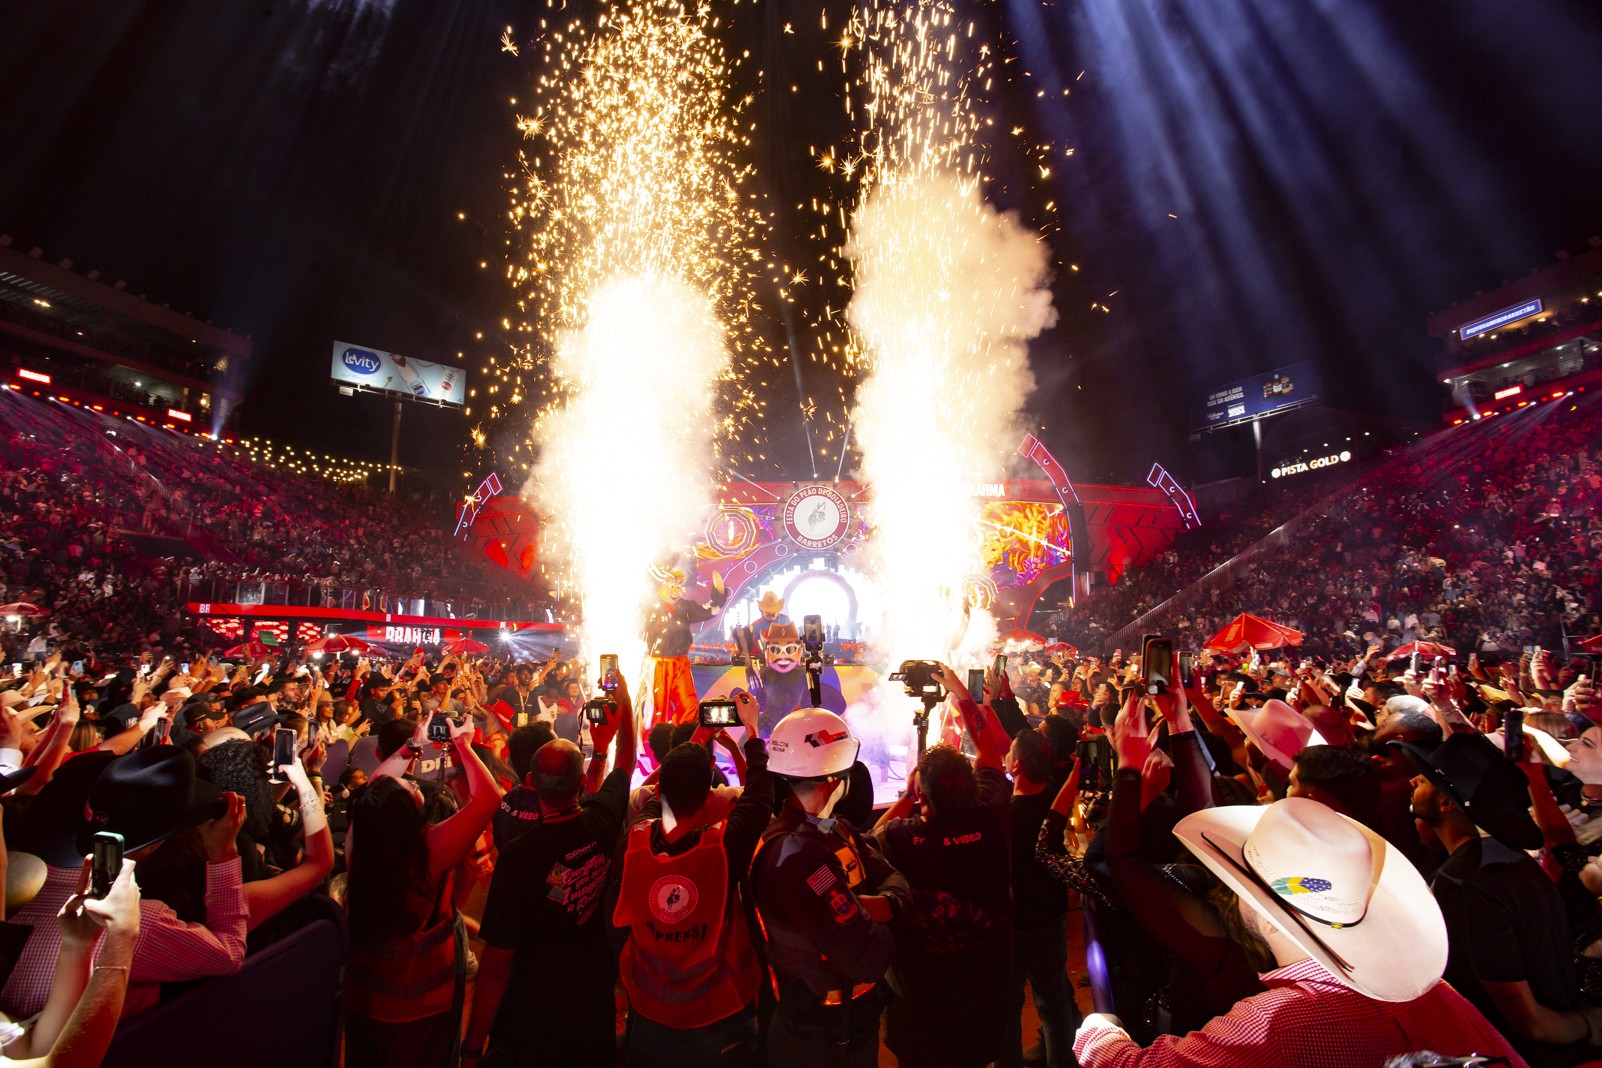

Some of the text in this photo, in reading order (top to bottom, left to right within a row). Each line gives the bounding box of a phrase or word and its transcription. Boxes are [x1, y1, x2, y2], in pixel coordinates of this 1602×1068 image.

[1281, 455, 1340, 477] PISTA GOLD
[786, 506, 795, 525] FESTA
[791, 496, 801, 507] DO
[827, 491, 847, 523] BOIADEIRO
[796, 535, 839, 548] BARRETOS
[943, 837, 951, 846] &
